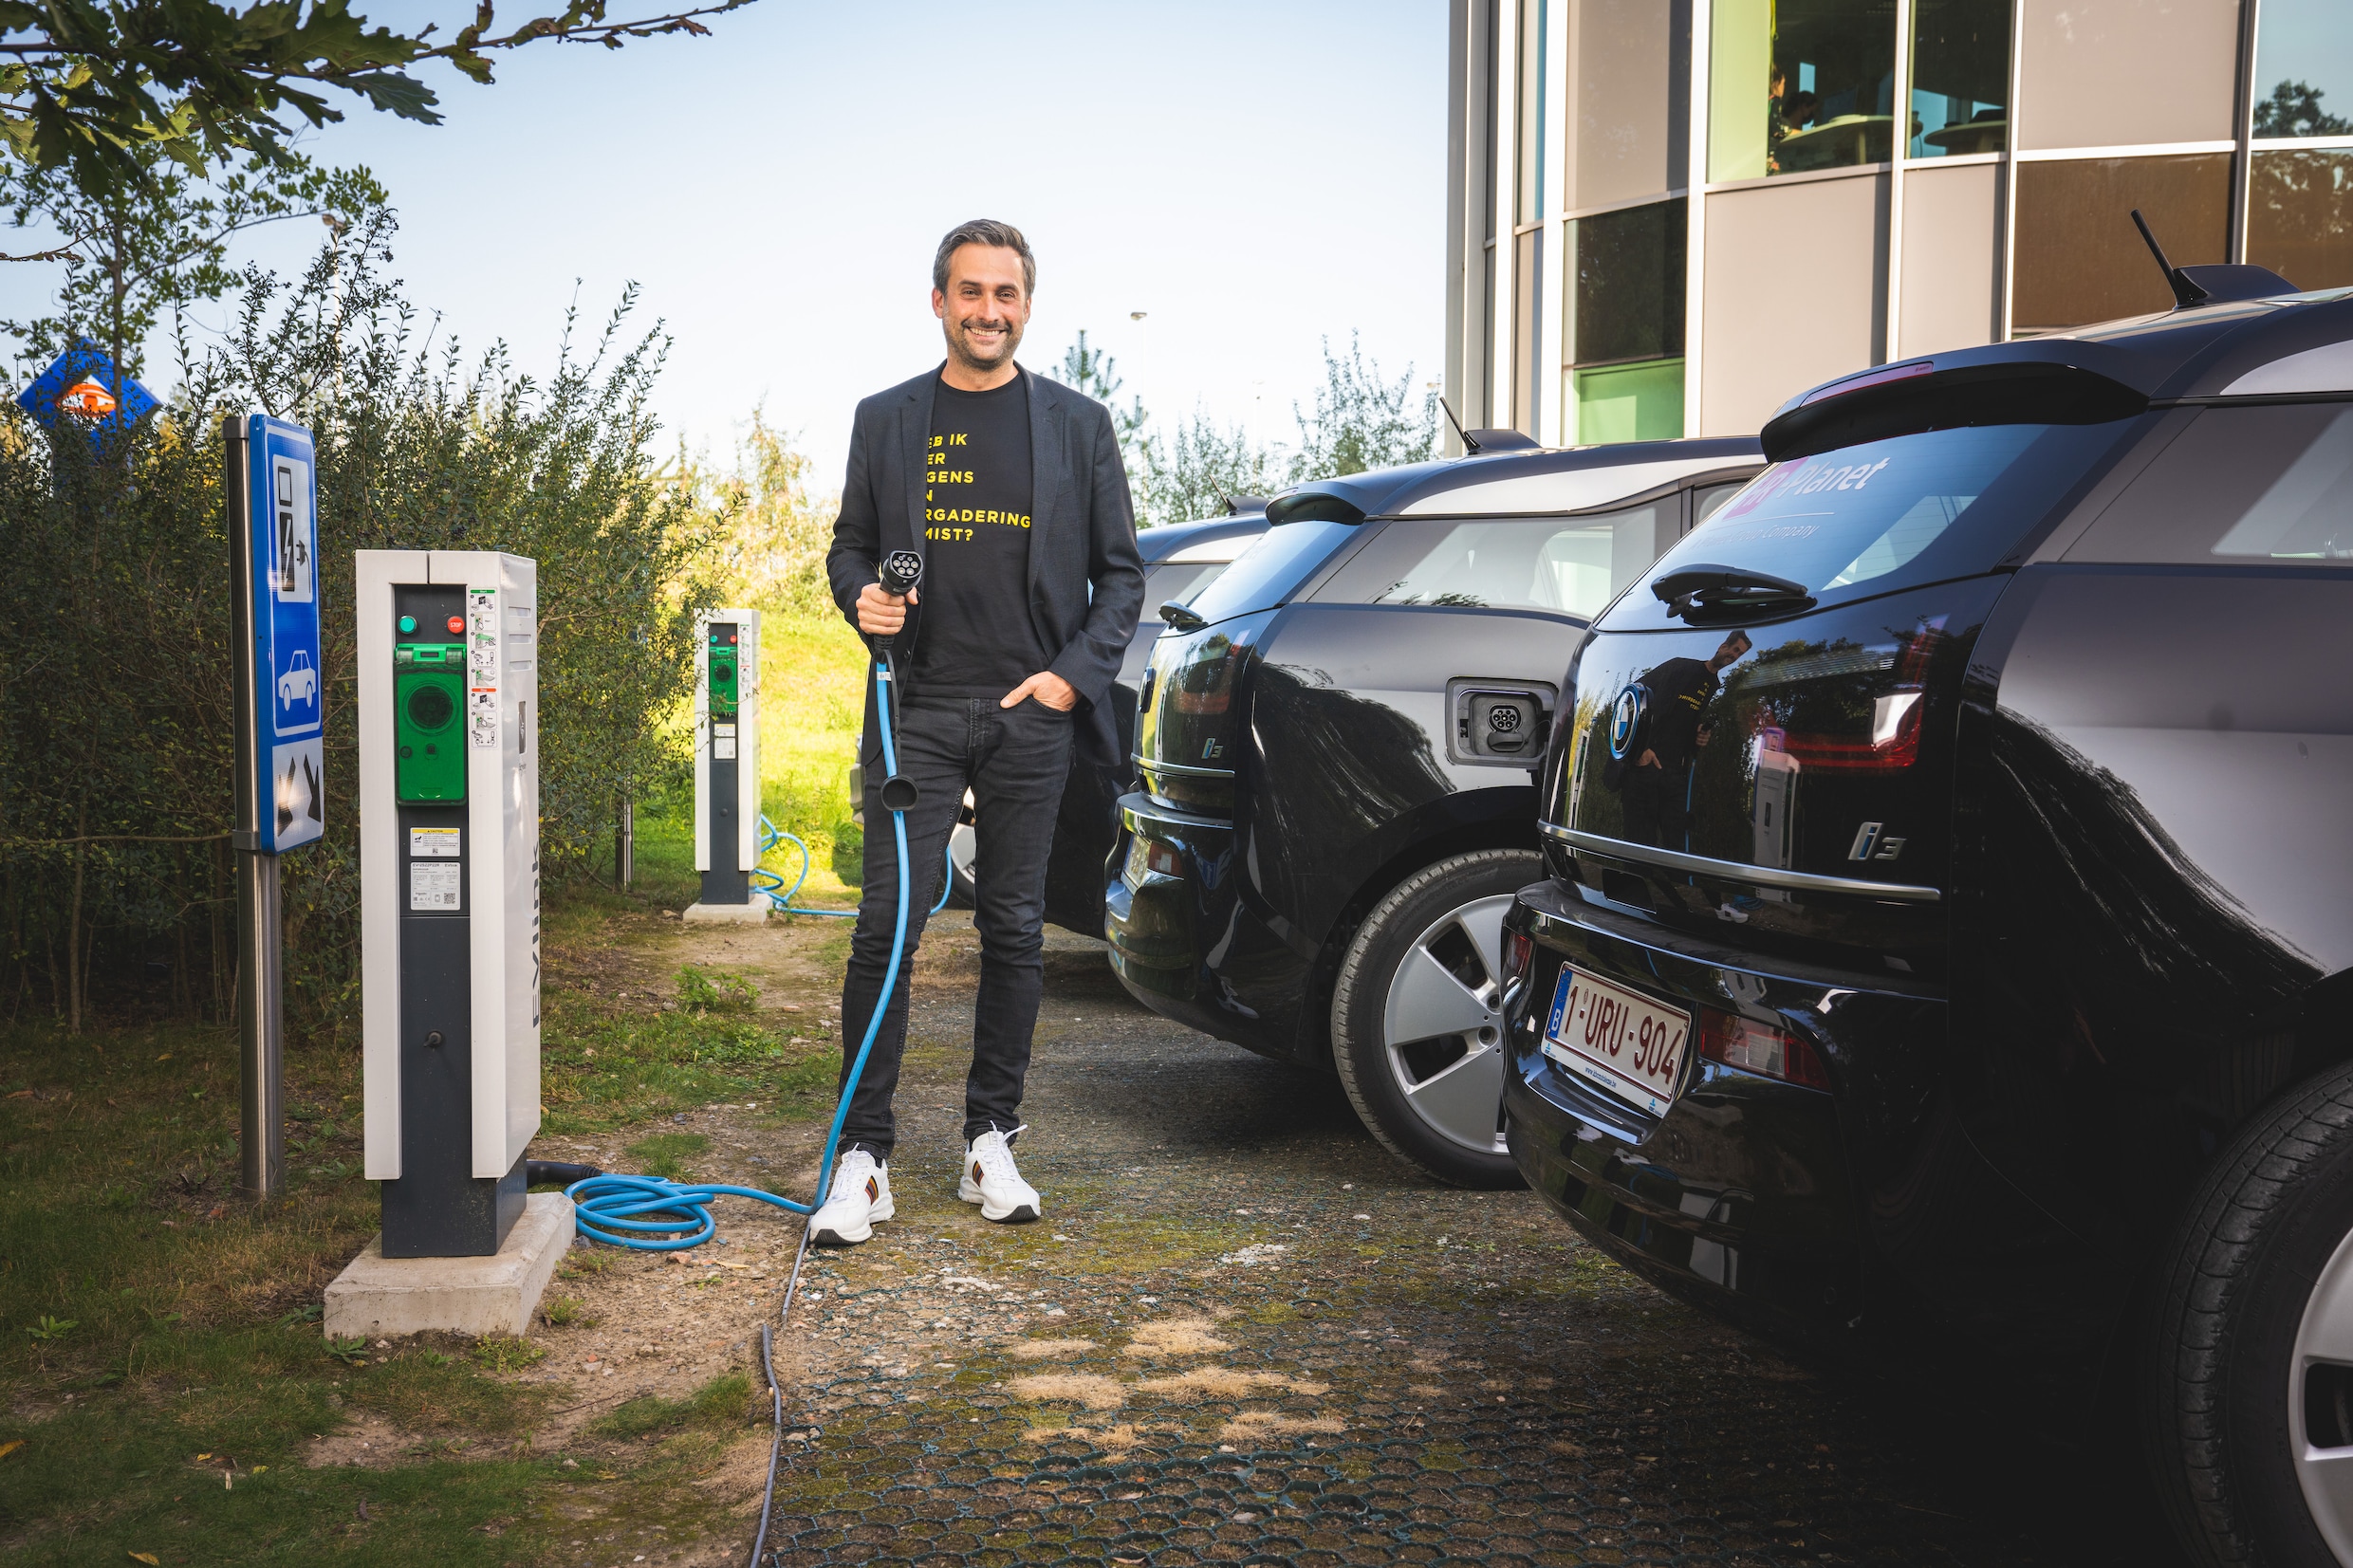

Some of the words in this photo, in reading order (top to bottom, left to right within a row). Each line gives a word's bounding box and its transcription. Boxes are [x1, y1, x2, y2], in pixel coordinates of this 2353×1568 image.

[949, 433, 968, 446] IK
[926, 470, 974, 484] GENS
[1762, 525, 1820, 539] Company
[1551, 1009, 1561, 1032] B
[1565, 985, 1683, 1084] 1-URU-904
